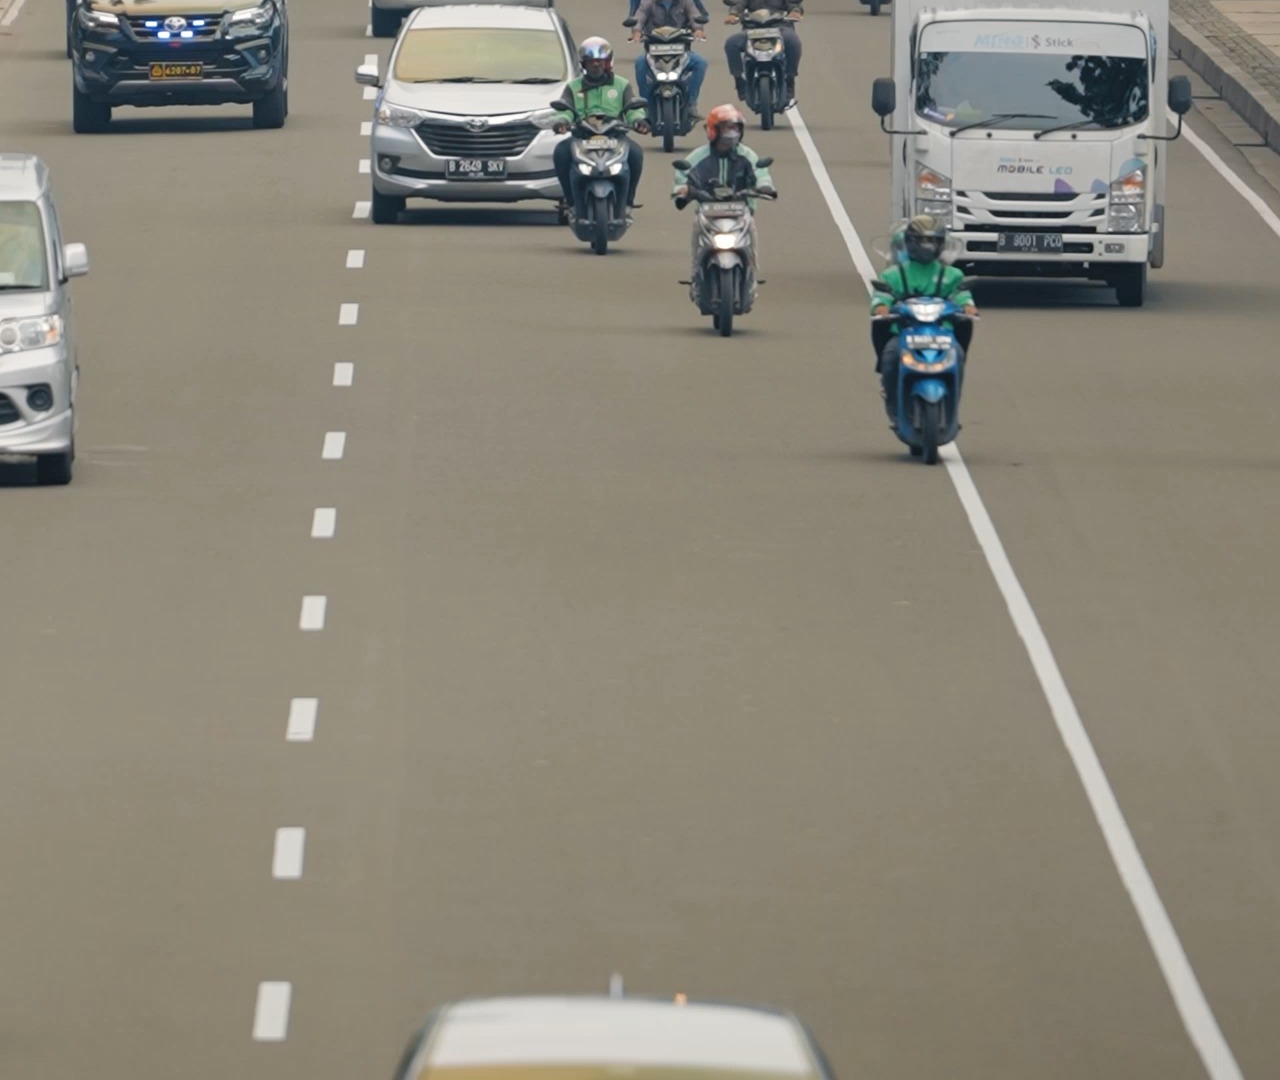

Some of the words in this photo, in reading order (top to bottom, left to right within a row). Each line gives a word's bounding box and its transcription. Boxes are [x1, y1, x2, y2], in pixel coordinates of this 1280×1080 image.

[1045, 37, 1073, 48] Stick
[449, 160, 456, 172] B
[997, 165, 1044, 174] MOBILE
[999, 234, 1006, 246] B
[1013, 234, 1037, 247] 9001
